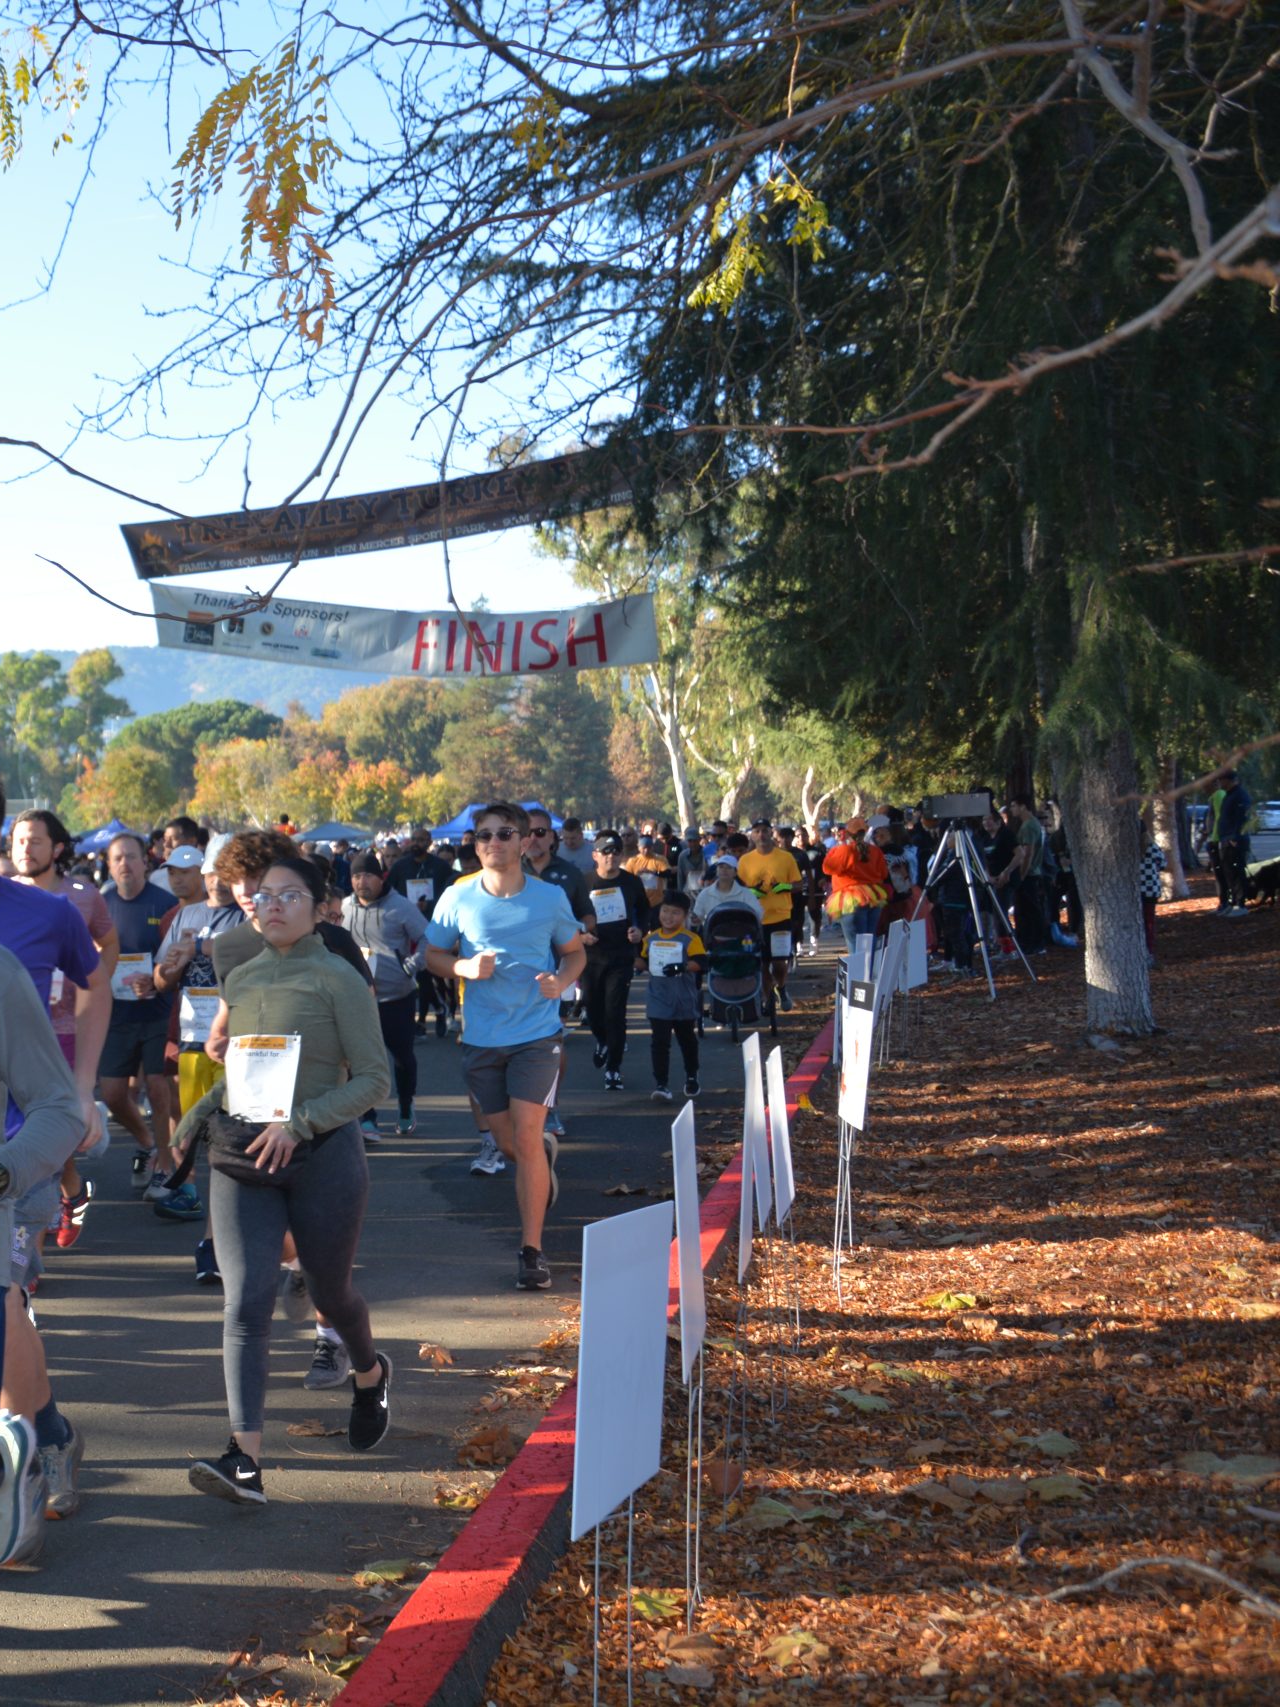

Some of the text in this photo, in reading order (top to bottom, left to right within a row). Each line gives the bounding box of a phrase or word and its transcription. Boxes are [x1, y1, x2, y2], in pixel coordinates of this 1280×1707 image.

[178, 560, 218, 574] FAMILY
[260, 549, 320, 565] WALK-UN
[334, 543, 357, 556] KEN
[359, 535, 406, 550] MERCER
[455, 523, 487, 536] PARK
[193, 592, 237, 609] Thank
[272, 602, 350, 623] Sponsors!
[411, 611, 608, 673] FINISH
